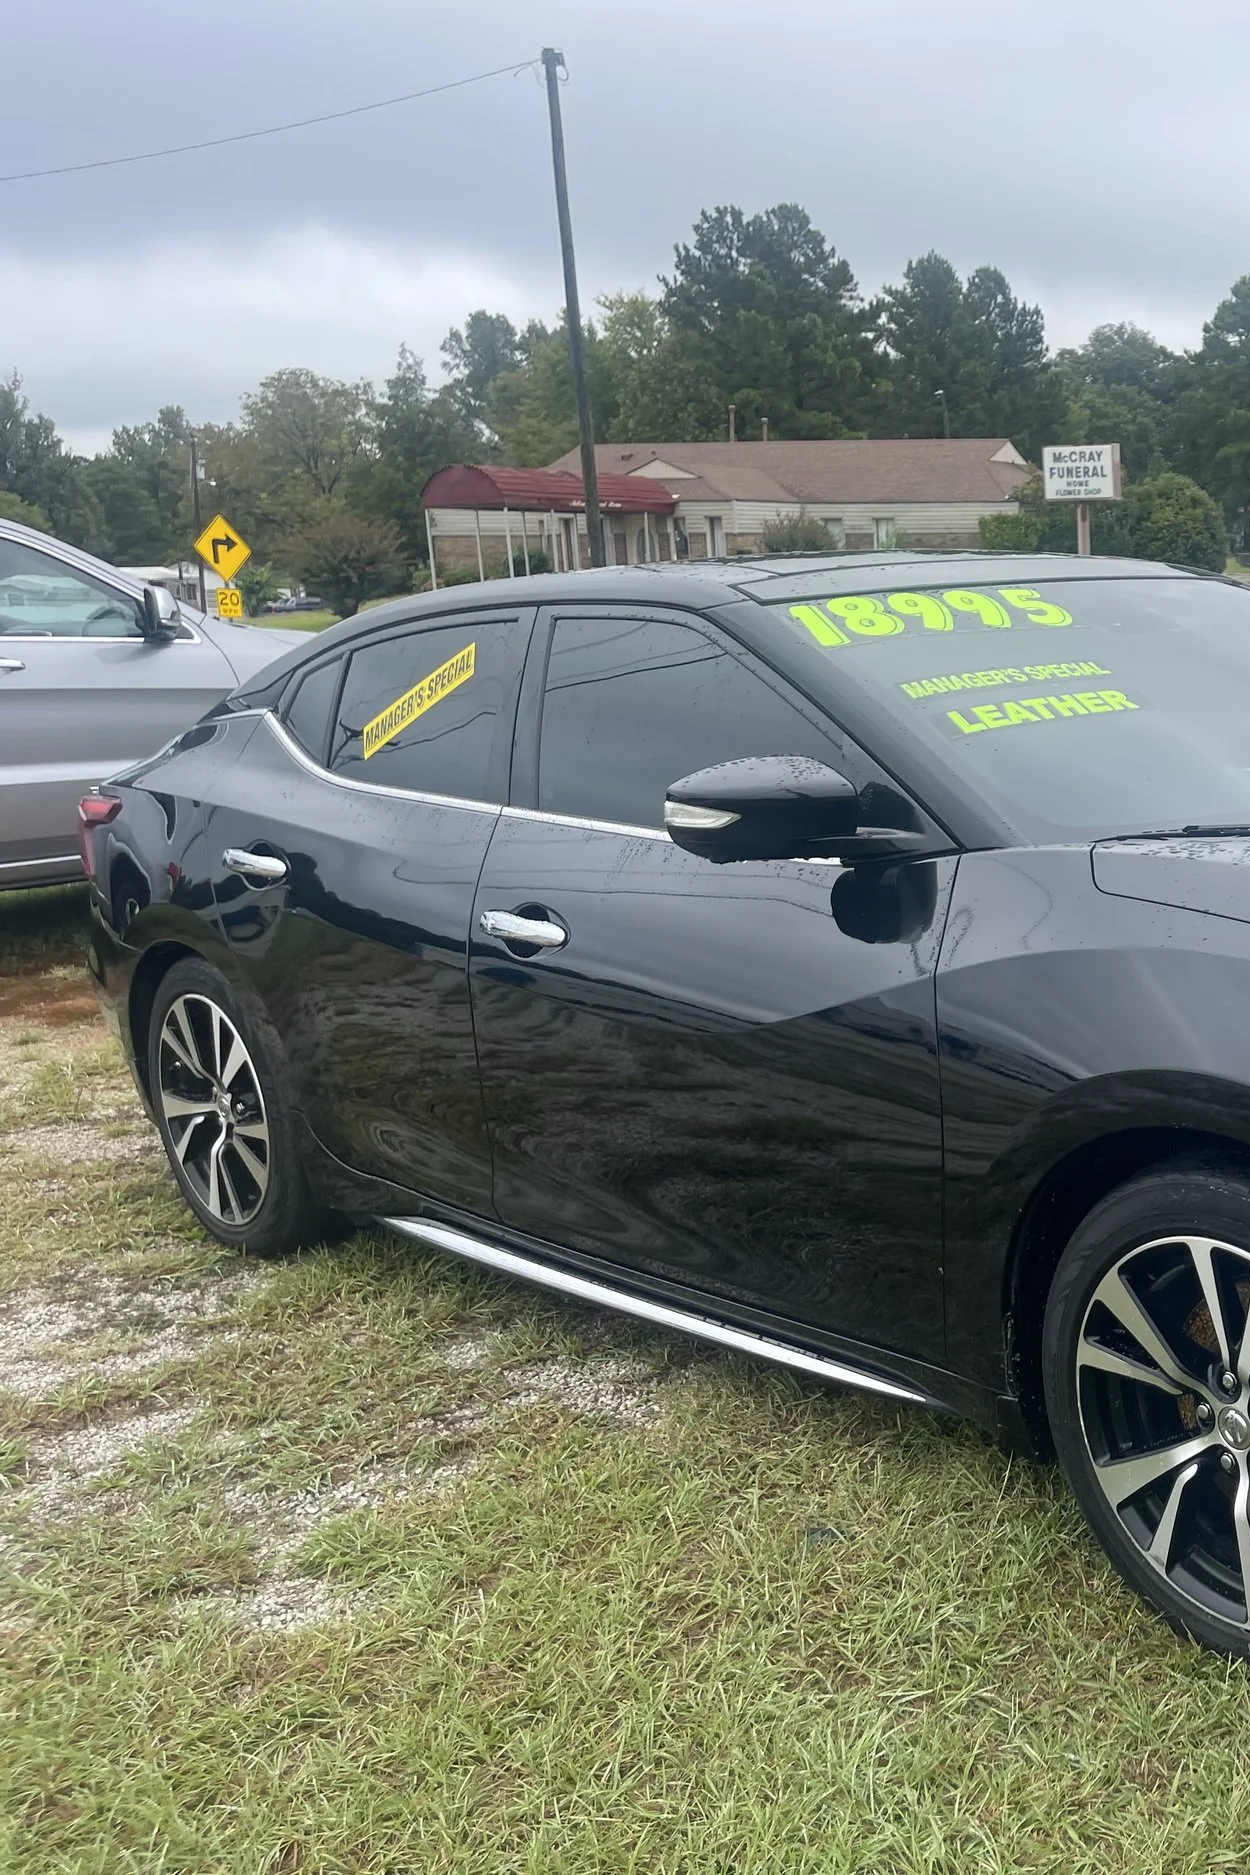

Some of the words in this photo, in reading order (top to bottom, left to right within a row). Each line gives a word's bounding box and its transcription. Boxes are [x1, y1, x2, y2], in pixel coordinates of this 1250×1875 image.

[1049, 465, 1107, 479] FUNERAL
[1053, 450, 1103, 464] McCRAY
[219, 591, 240, 606] 20
[789, 589, 1073, 647] 18995
[900, 667, 1030, 699] MANAGER'S
[1023, 661, 1111, 681] SPECIAL
[366, 686, 426, 751] MANAGER'S
[427, 649, 473, 699] SPECIAL
[946, 689, 1140, 734] LEATHER
